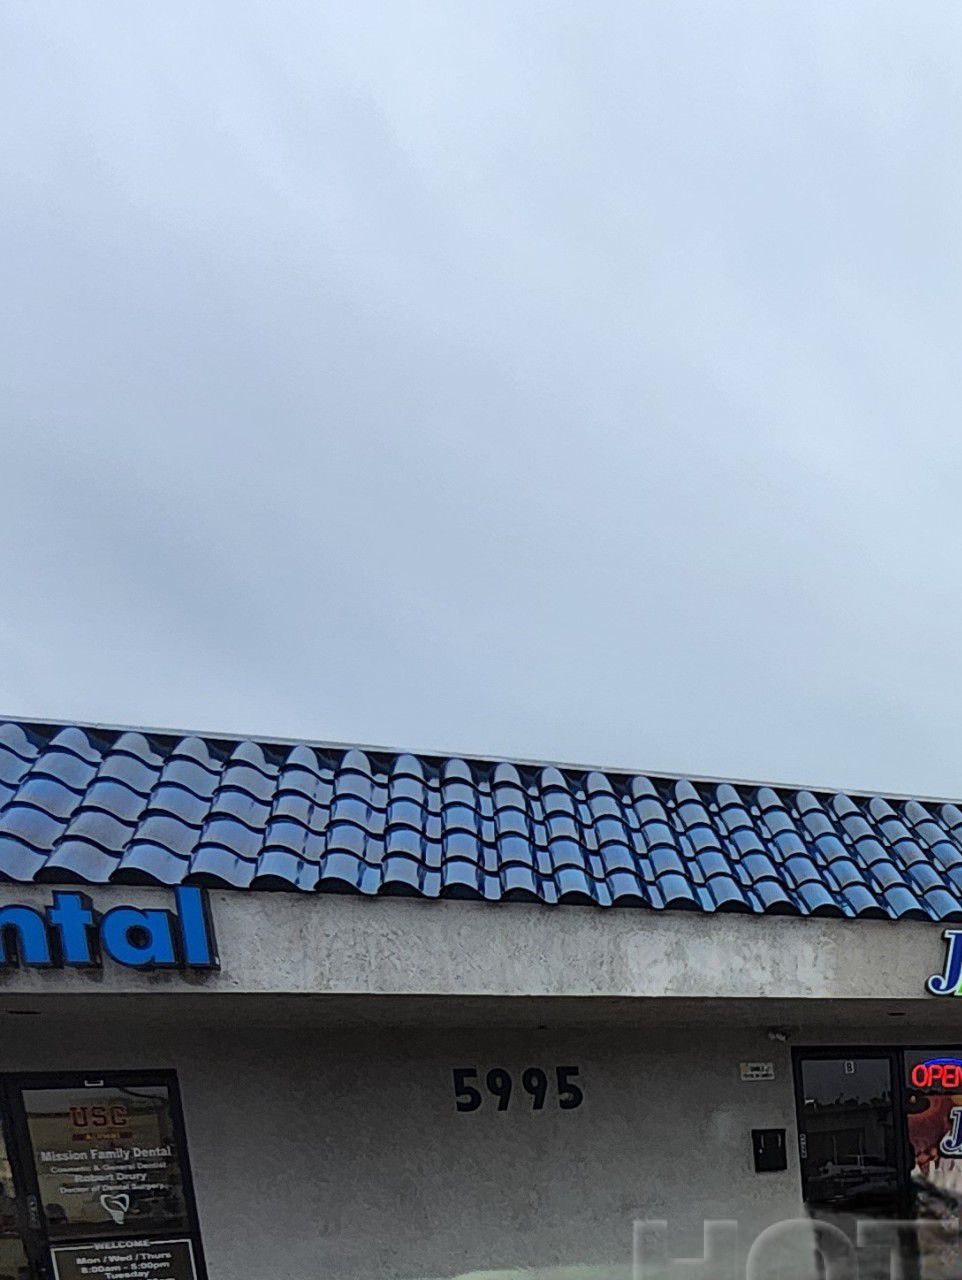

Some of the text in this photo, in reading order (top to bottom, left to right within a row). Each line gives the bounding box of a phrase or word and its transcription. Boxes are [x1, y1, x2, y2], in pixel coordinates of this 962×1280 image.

[453, 1066, 584, 1112] 5995
[69, 1106, 127, 1127] USC
[40, 1146, 171, 1162] Mission Family Dental
[116, 1173, 147, 1182] Drury
[94, 1240, 150, 1250] WELCOME
[104, 1271, 150, 1280] Tuesday
